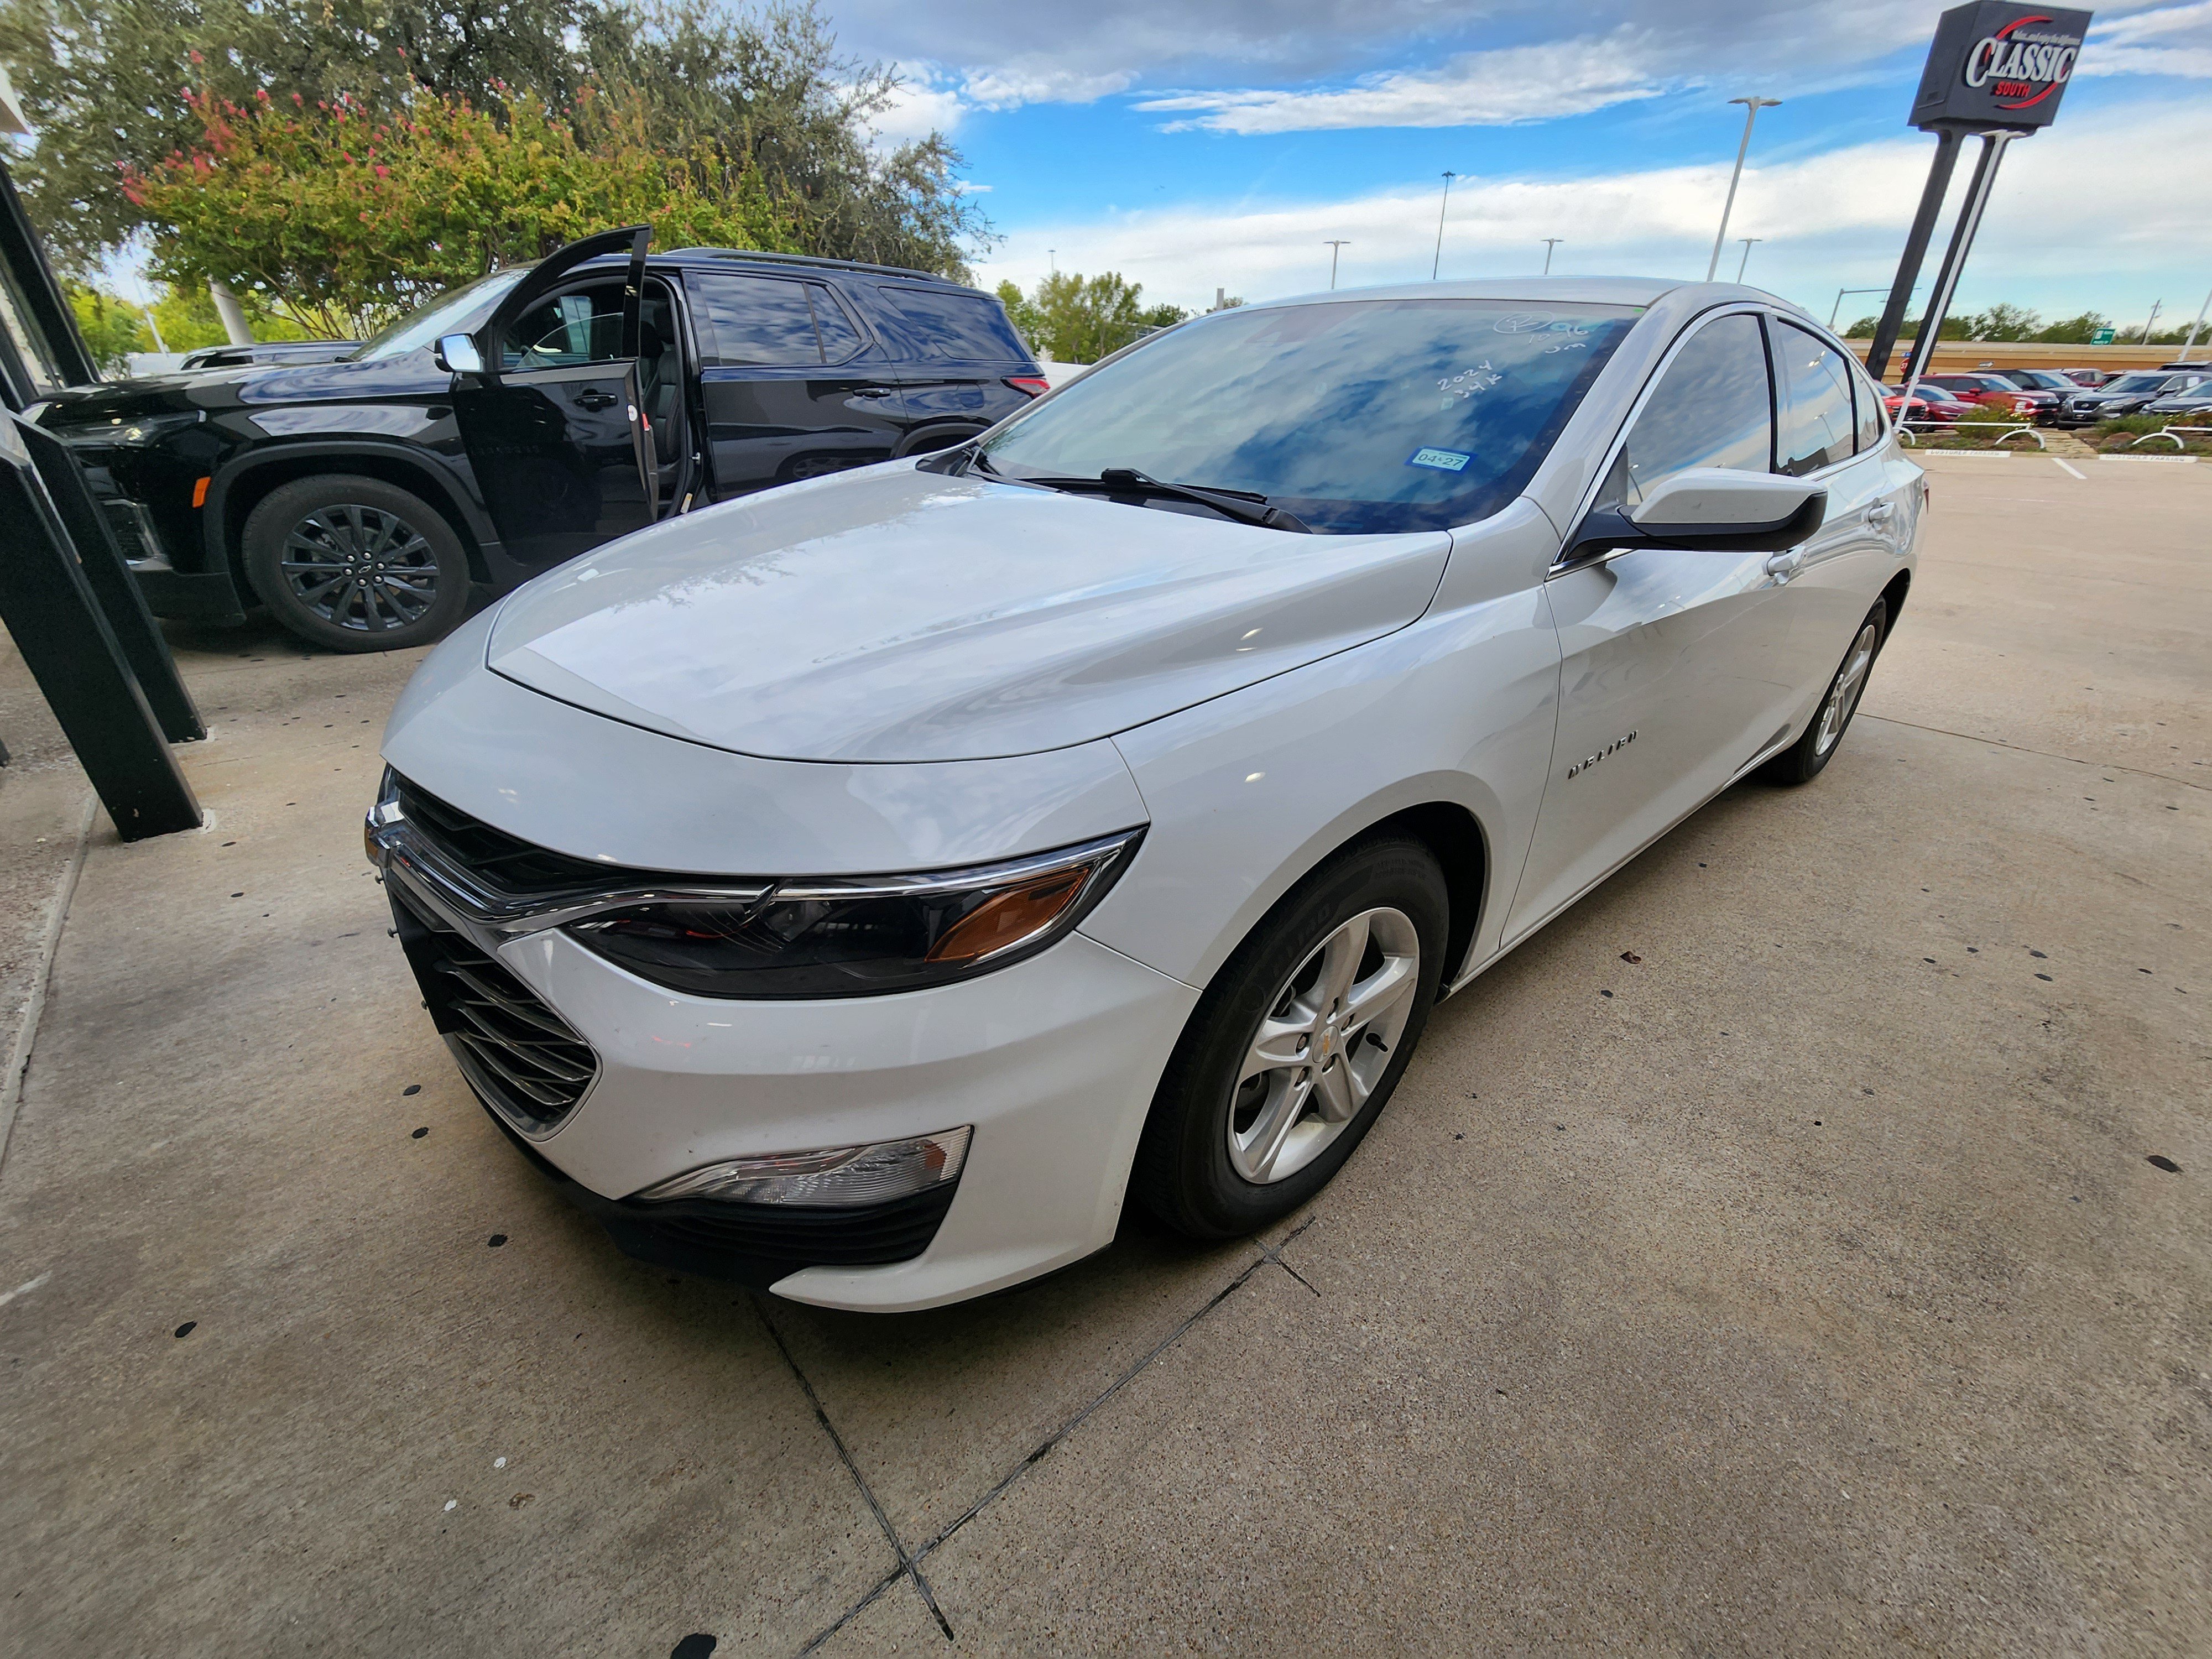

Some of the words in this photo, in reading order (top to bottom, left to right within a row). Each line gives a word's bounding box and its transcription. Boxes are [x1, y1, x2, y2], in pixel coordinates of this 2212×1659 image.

[1966, 37, 2077, 87] CLASSIC
[1994, 81, 2031, 97] SOUTH
[1437, 359, 1493, 391] 2024
